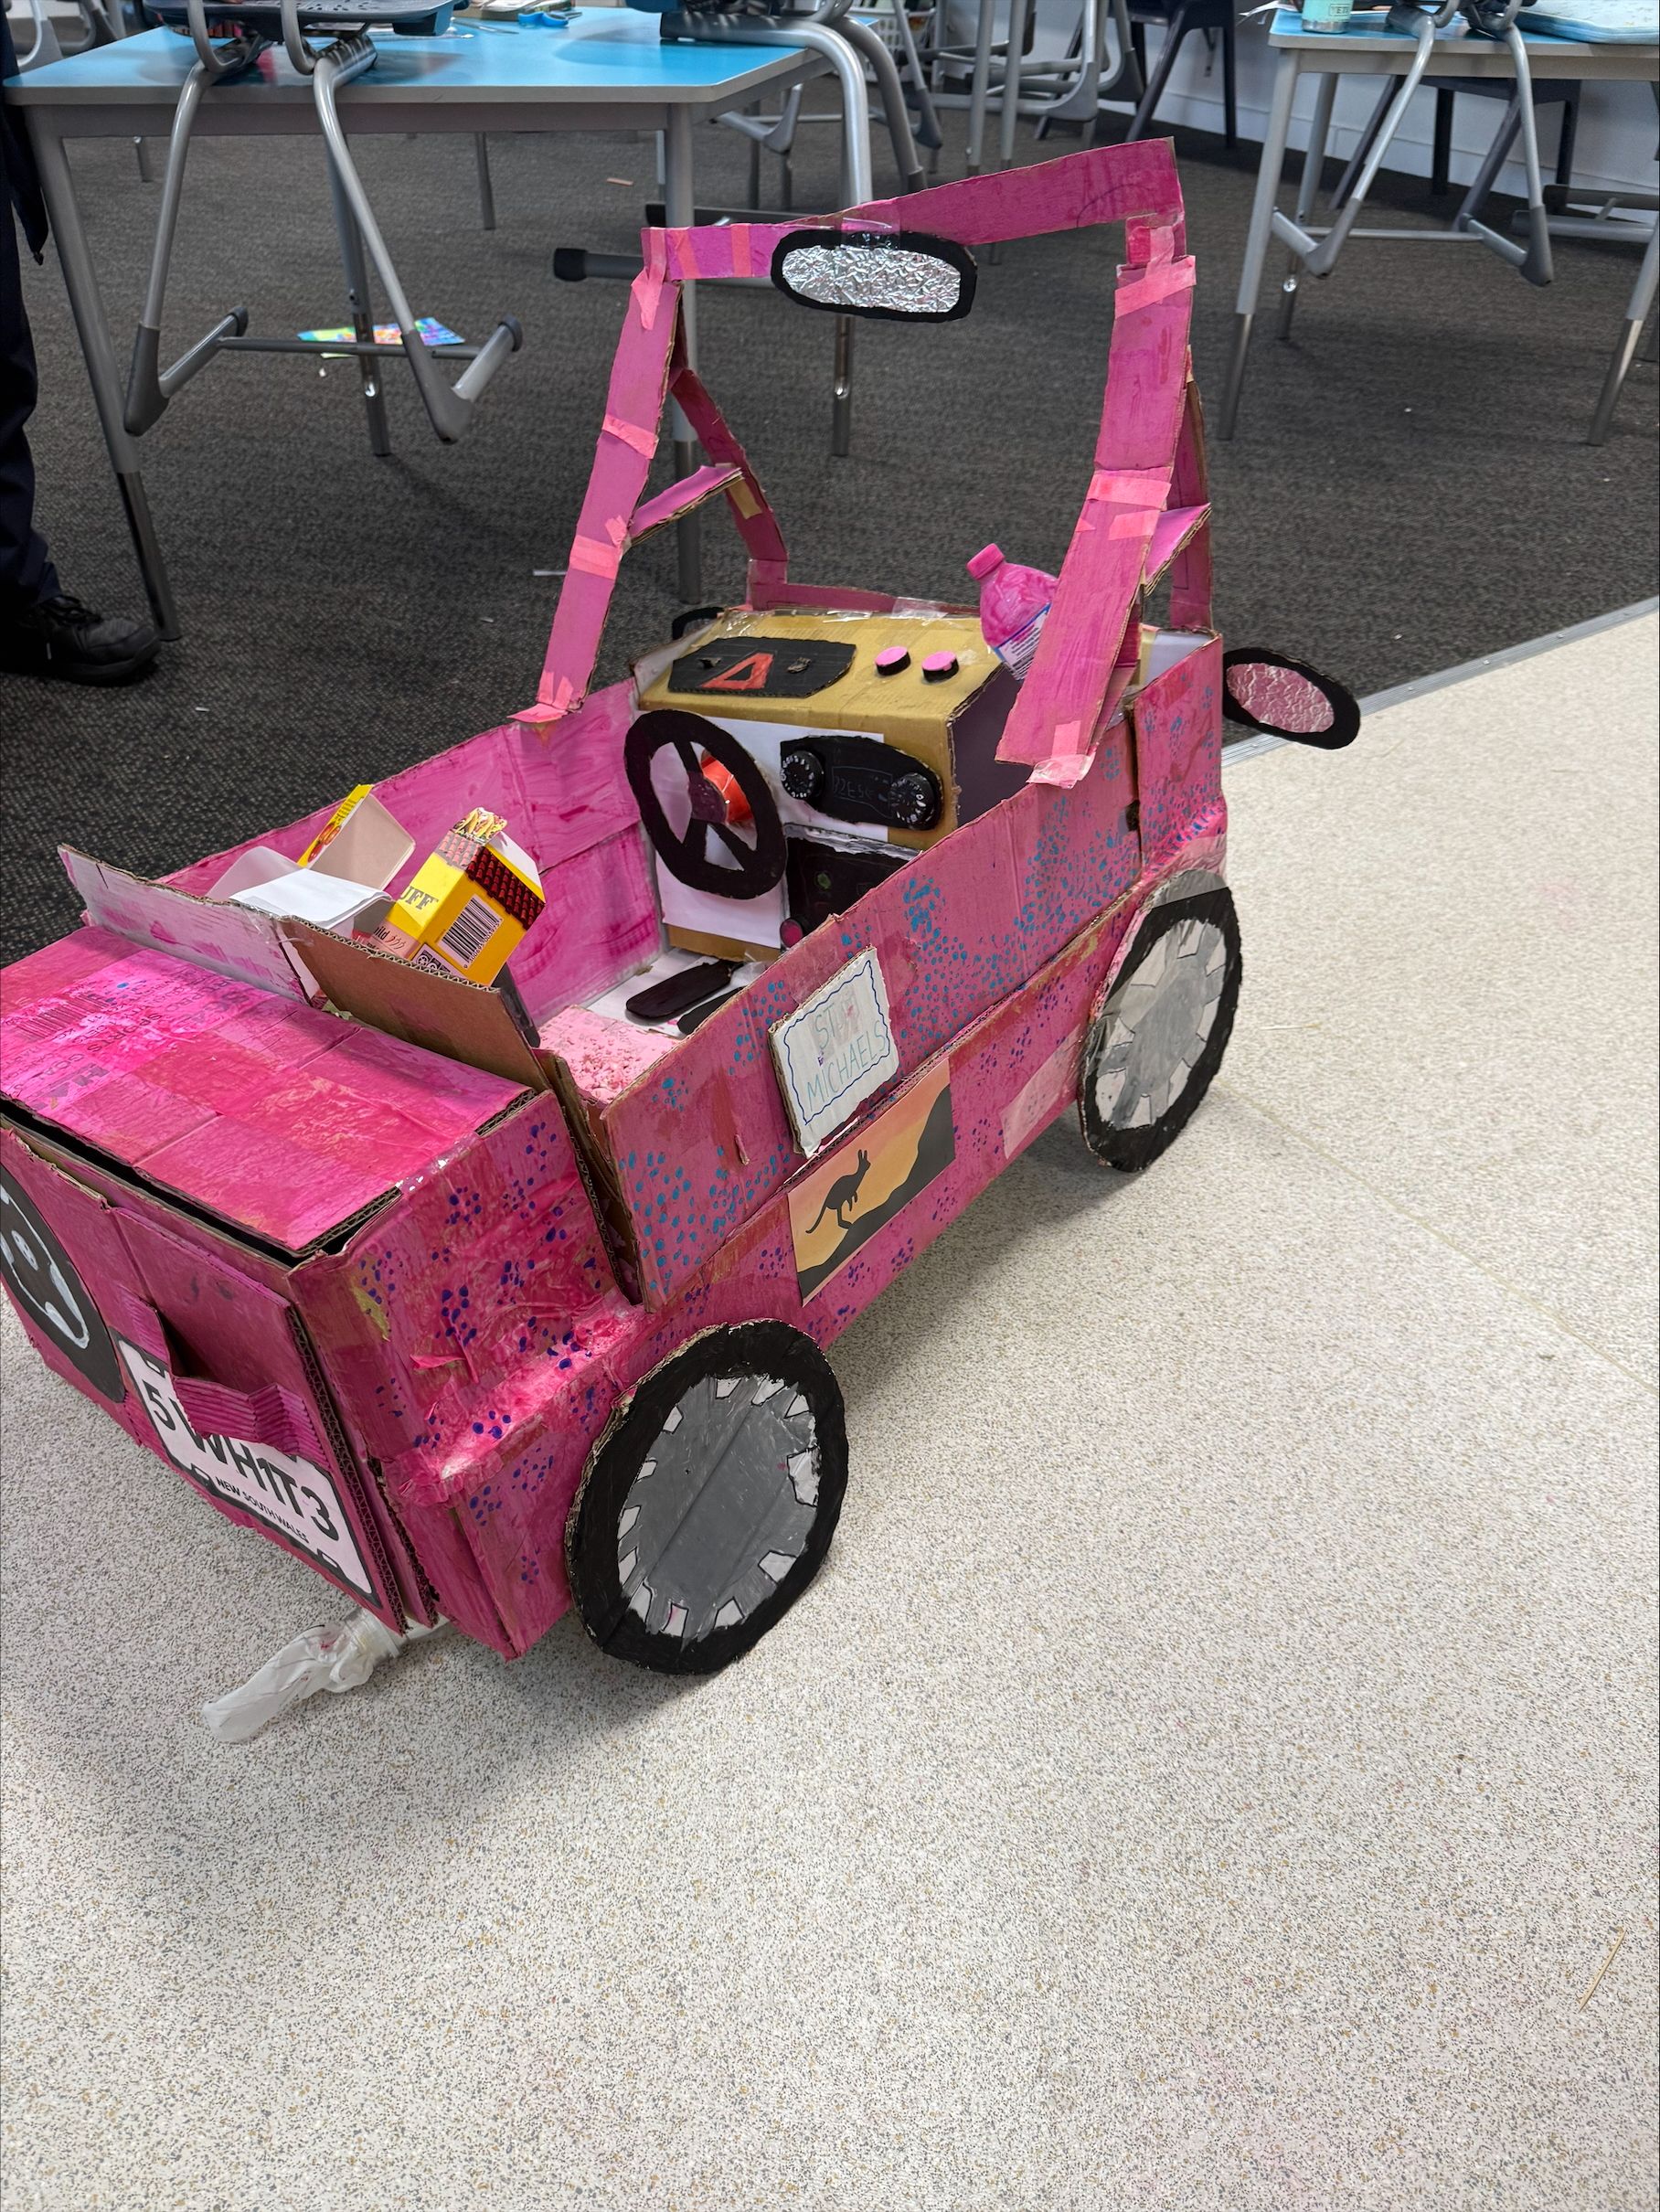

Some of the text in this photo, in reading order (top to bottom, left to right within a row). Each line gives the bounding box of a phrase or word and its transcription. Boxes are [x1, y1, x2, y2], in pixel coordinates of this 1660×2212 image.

[83, 1012, 164, 1052] SPORTS
[806, 1020, 886, 1111] MICHAELS
[216, 1476, 309, 1544] NEW SOUTH WALES
